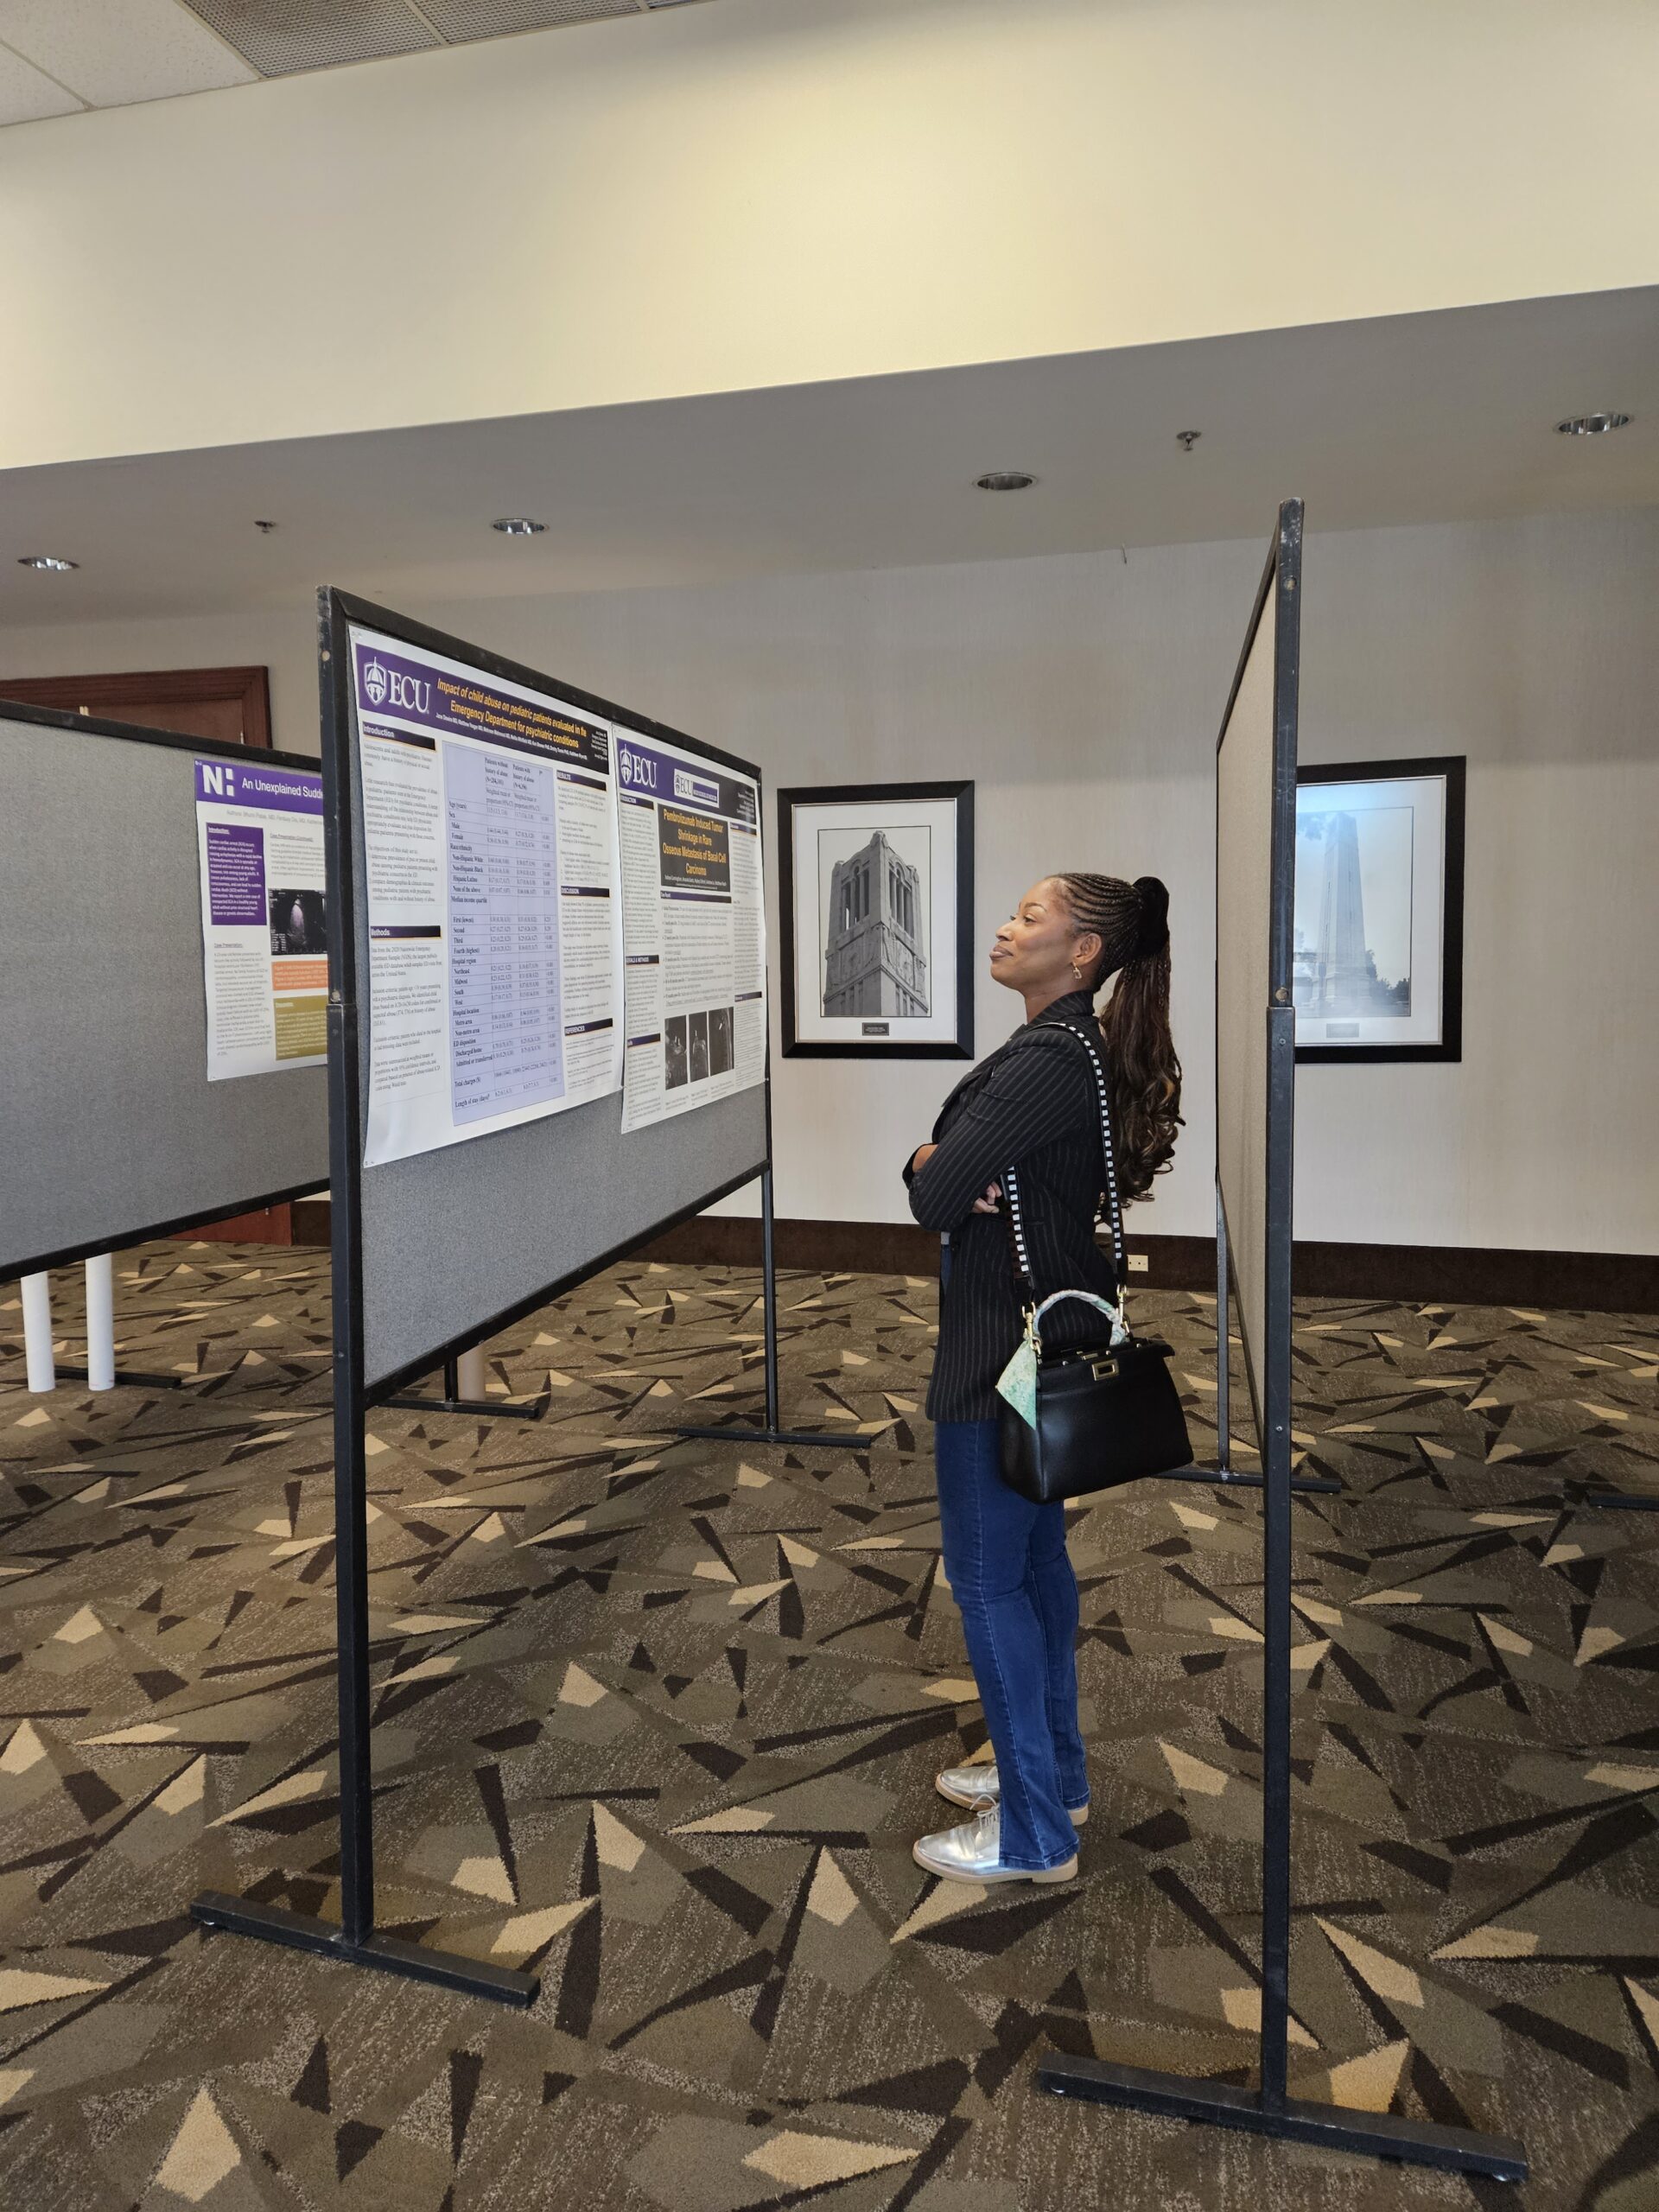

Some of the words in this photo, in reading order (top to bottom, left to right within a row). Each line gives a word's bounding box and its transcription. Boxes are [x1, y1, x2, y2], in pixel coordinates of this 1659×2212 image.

[388, 671, 430, 713] ECU
[437, 677, 460, 695] Impact
[461, 686, 468, 698] of
[468, 690, 484, 704] child
[484, 695, 501, 709] abuse
[502, 702, 509, 711] on
[510, 705, 532, 720] pediatric
[532, 712, 552, 726] patients
[552, 718, 575, 734] evaluated
[575, 724, 581, 734] in
[363, 725, 394, 737] Introduction
[450, 700, 484, 722] Emergency
[485, 710, 517, 730] Department
[517, 721, 525, 733] for
[525, 725, 552, 741] psychiatric
[553, 734, 579, 748] conditions
[632, 754, 657, 789] ECU
[242, 778, 253, 789] An
[255, 779, 302, 796] Unexplained
[680, 777, 692, 795] ECU
[664, 809, 696, 827] Pembrolizumab
[696, 816, 711, 830] Induced
[711, 820, 723, 833] Tumor
[678, 829, 698, 845] Shrinkage
[698, 833, 702, 843] in
[702, 834, 712, 846] Rare
[663, 842, 682, 856] Osseous
[682, 845, 702, 860] Metastasis
[702, 850, 708, 861] of
[708, 850, 718, 862] Basal
[686, 862, 707, 876] Carcinoma
